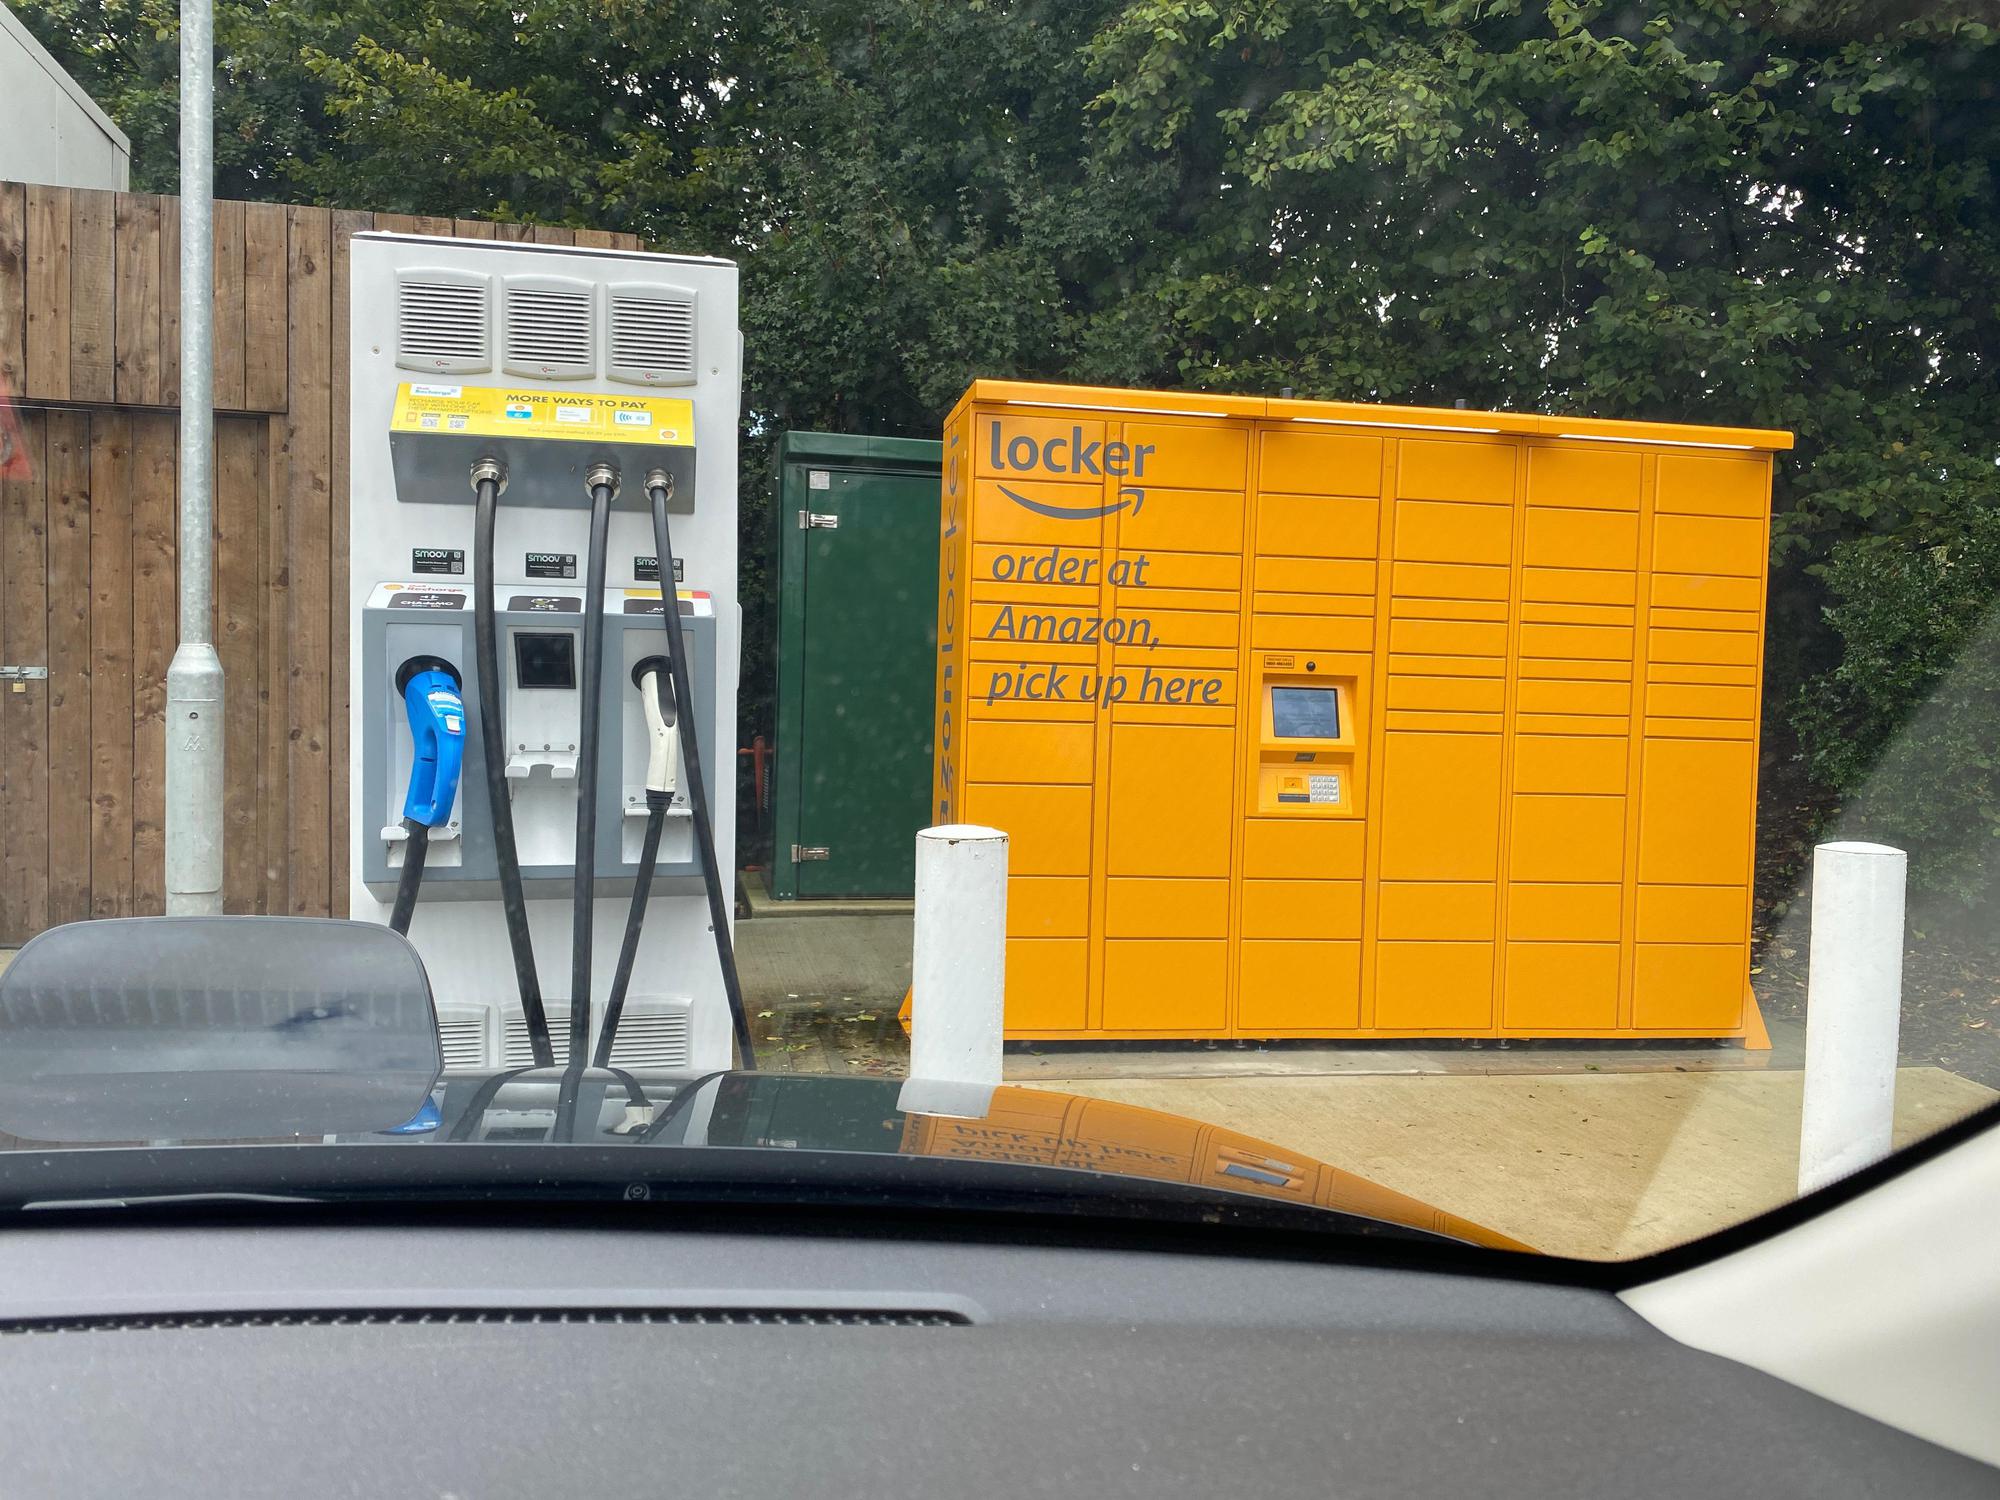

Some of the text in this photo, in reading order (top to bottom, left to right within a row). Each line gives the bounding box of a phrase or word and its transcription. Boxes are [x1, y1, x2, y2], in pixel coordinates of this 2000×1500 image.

[506, 393, 647, 409] MORE WAYS TO PAY
[991, 420, 1155, 478] locker
[992, 547, 1150, 586] order at
[988, 605, 1160, 651] Amazon,
[987, 663, 1223, 709] pick up here
